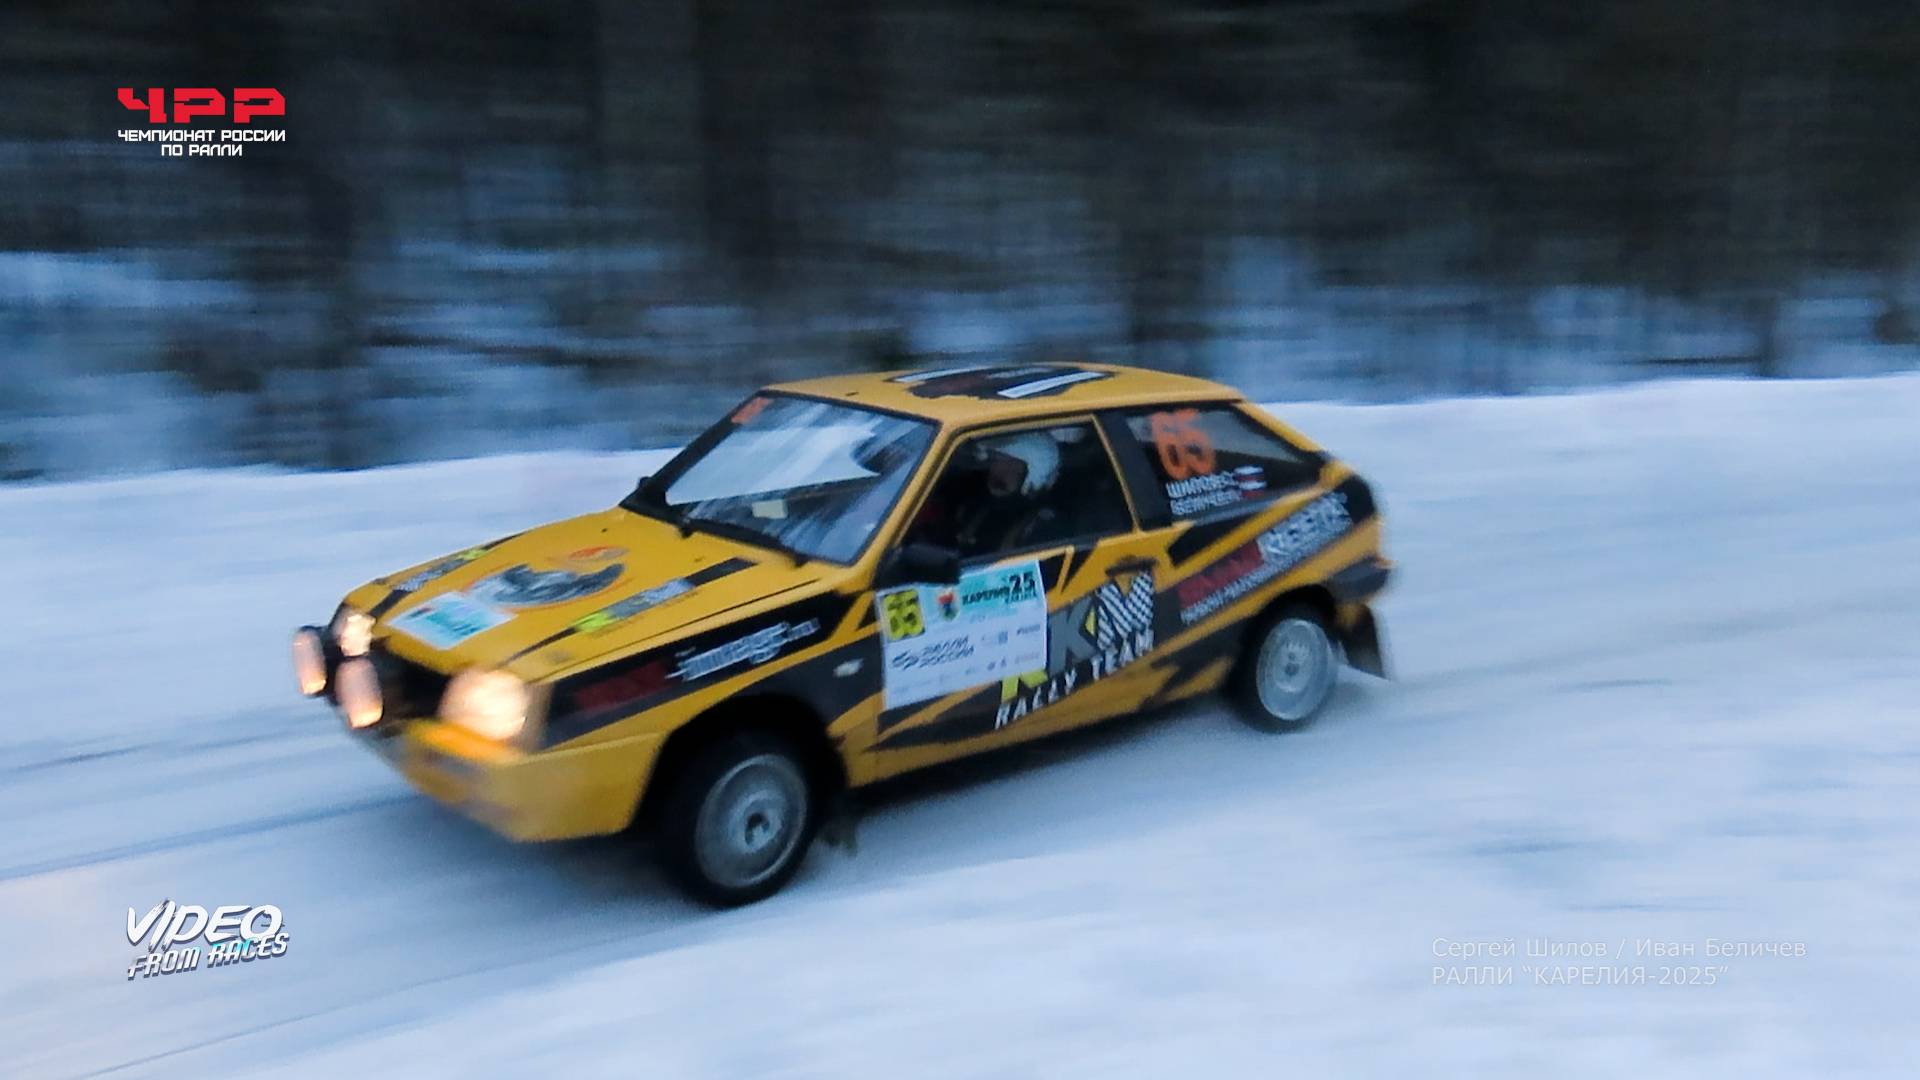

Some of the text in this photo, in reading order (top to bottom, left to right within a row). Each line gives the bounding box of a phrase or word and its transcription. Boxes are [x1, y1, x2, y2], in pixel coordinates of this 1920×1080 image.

[1151, 408, 1217, 480] 65
[1009, 571, 1036, 596] 25
[995, 629, 1155, 730] RALLY TEAM
